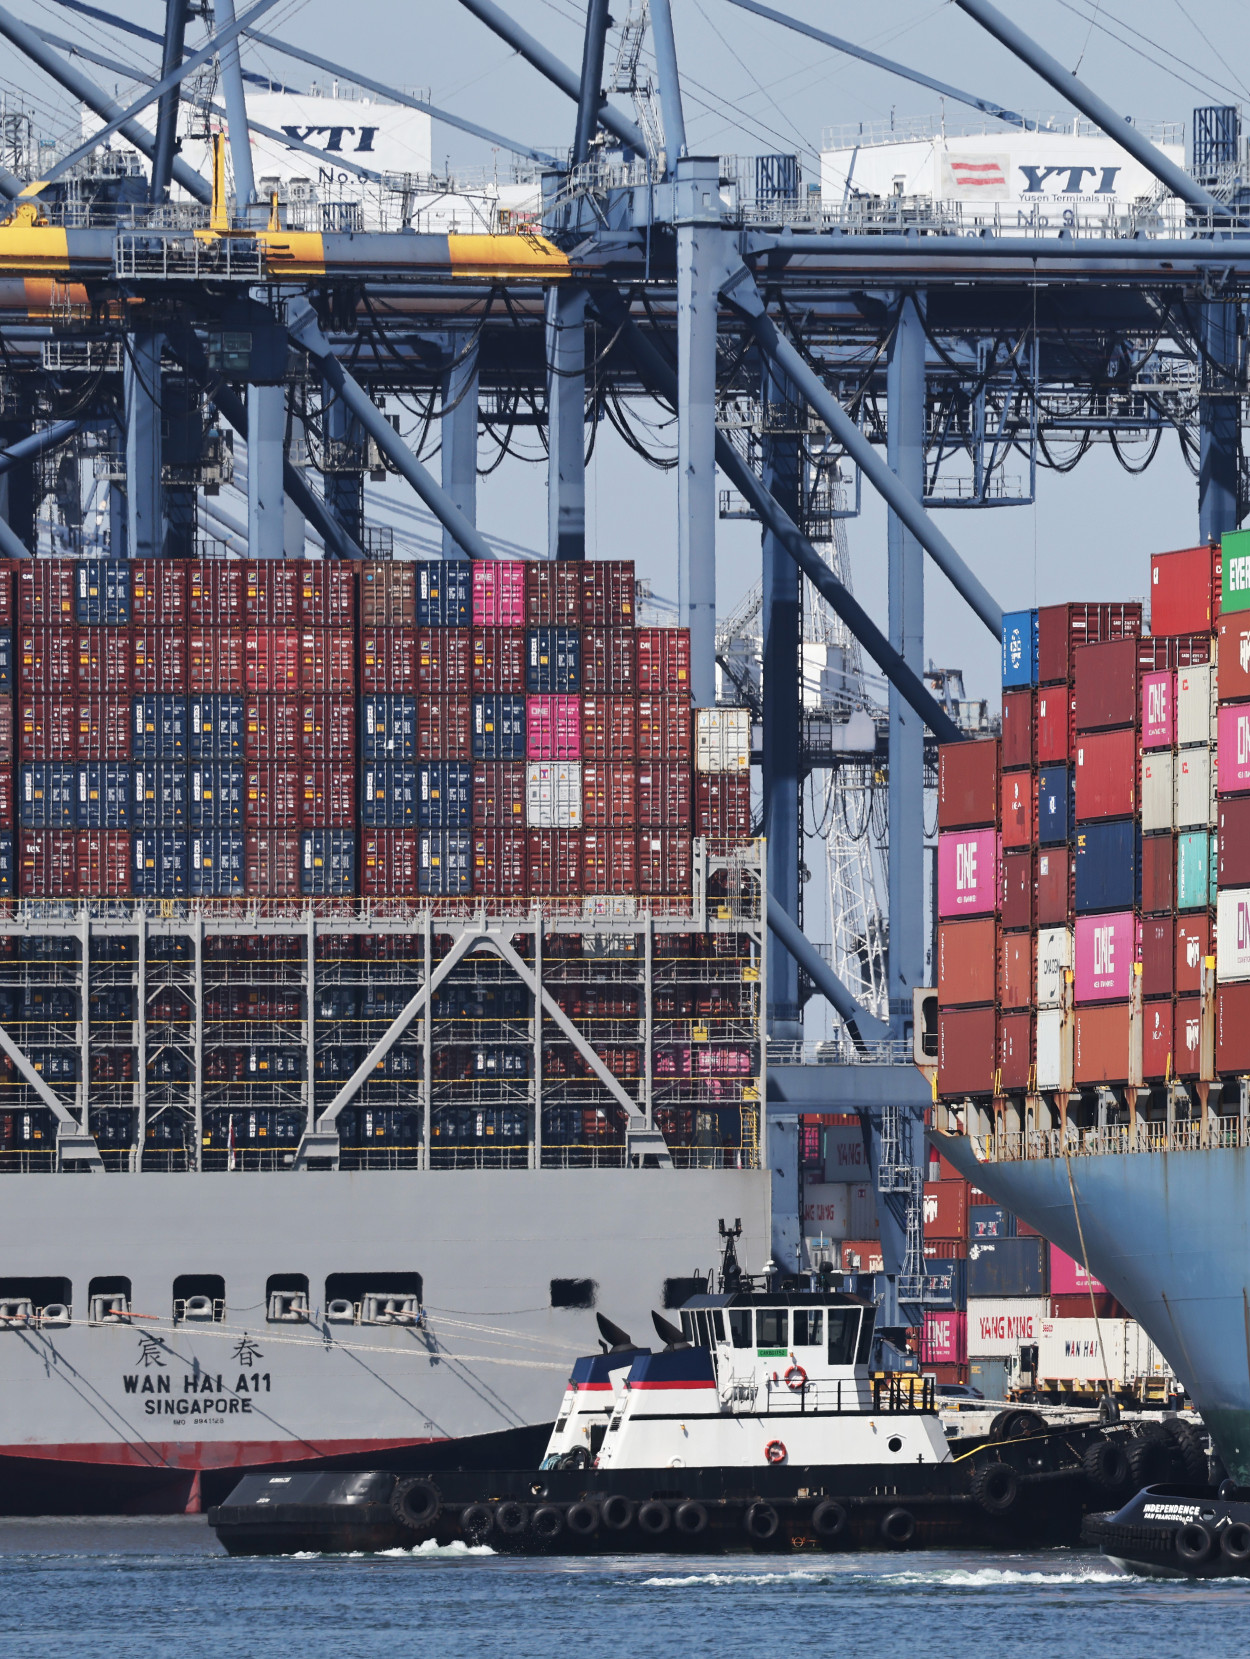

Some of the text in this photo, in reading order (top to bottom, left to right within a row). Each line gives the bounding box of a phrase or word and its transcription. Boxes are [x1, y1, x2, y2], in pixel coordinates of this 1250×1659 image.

[281, 125, 379, 152] YTI
[1018, 165, 1122, 194] YTI
[1018, 193, 1121, 204] Yusen Terminals Inc.
[1149, 682, 1166, 723] ONE
[957, 842, 977, 889] ONE
[1094, 926, 1114, 974] ONE
[980, 1316, 1033, 1339] YANG MING
[1065, 1341, 1098, 1357] WAN HAI
[123, 1373, 271, 1393] WAN HAI A11
[145, 1398, 252, 1415] SINGAPORE
[1143, 1503, 1201, 1516] INDEPENDENCE
